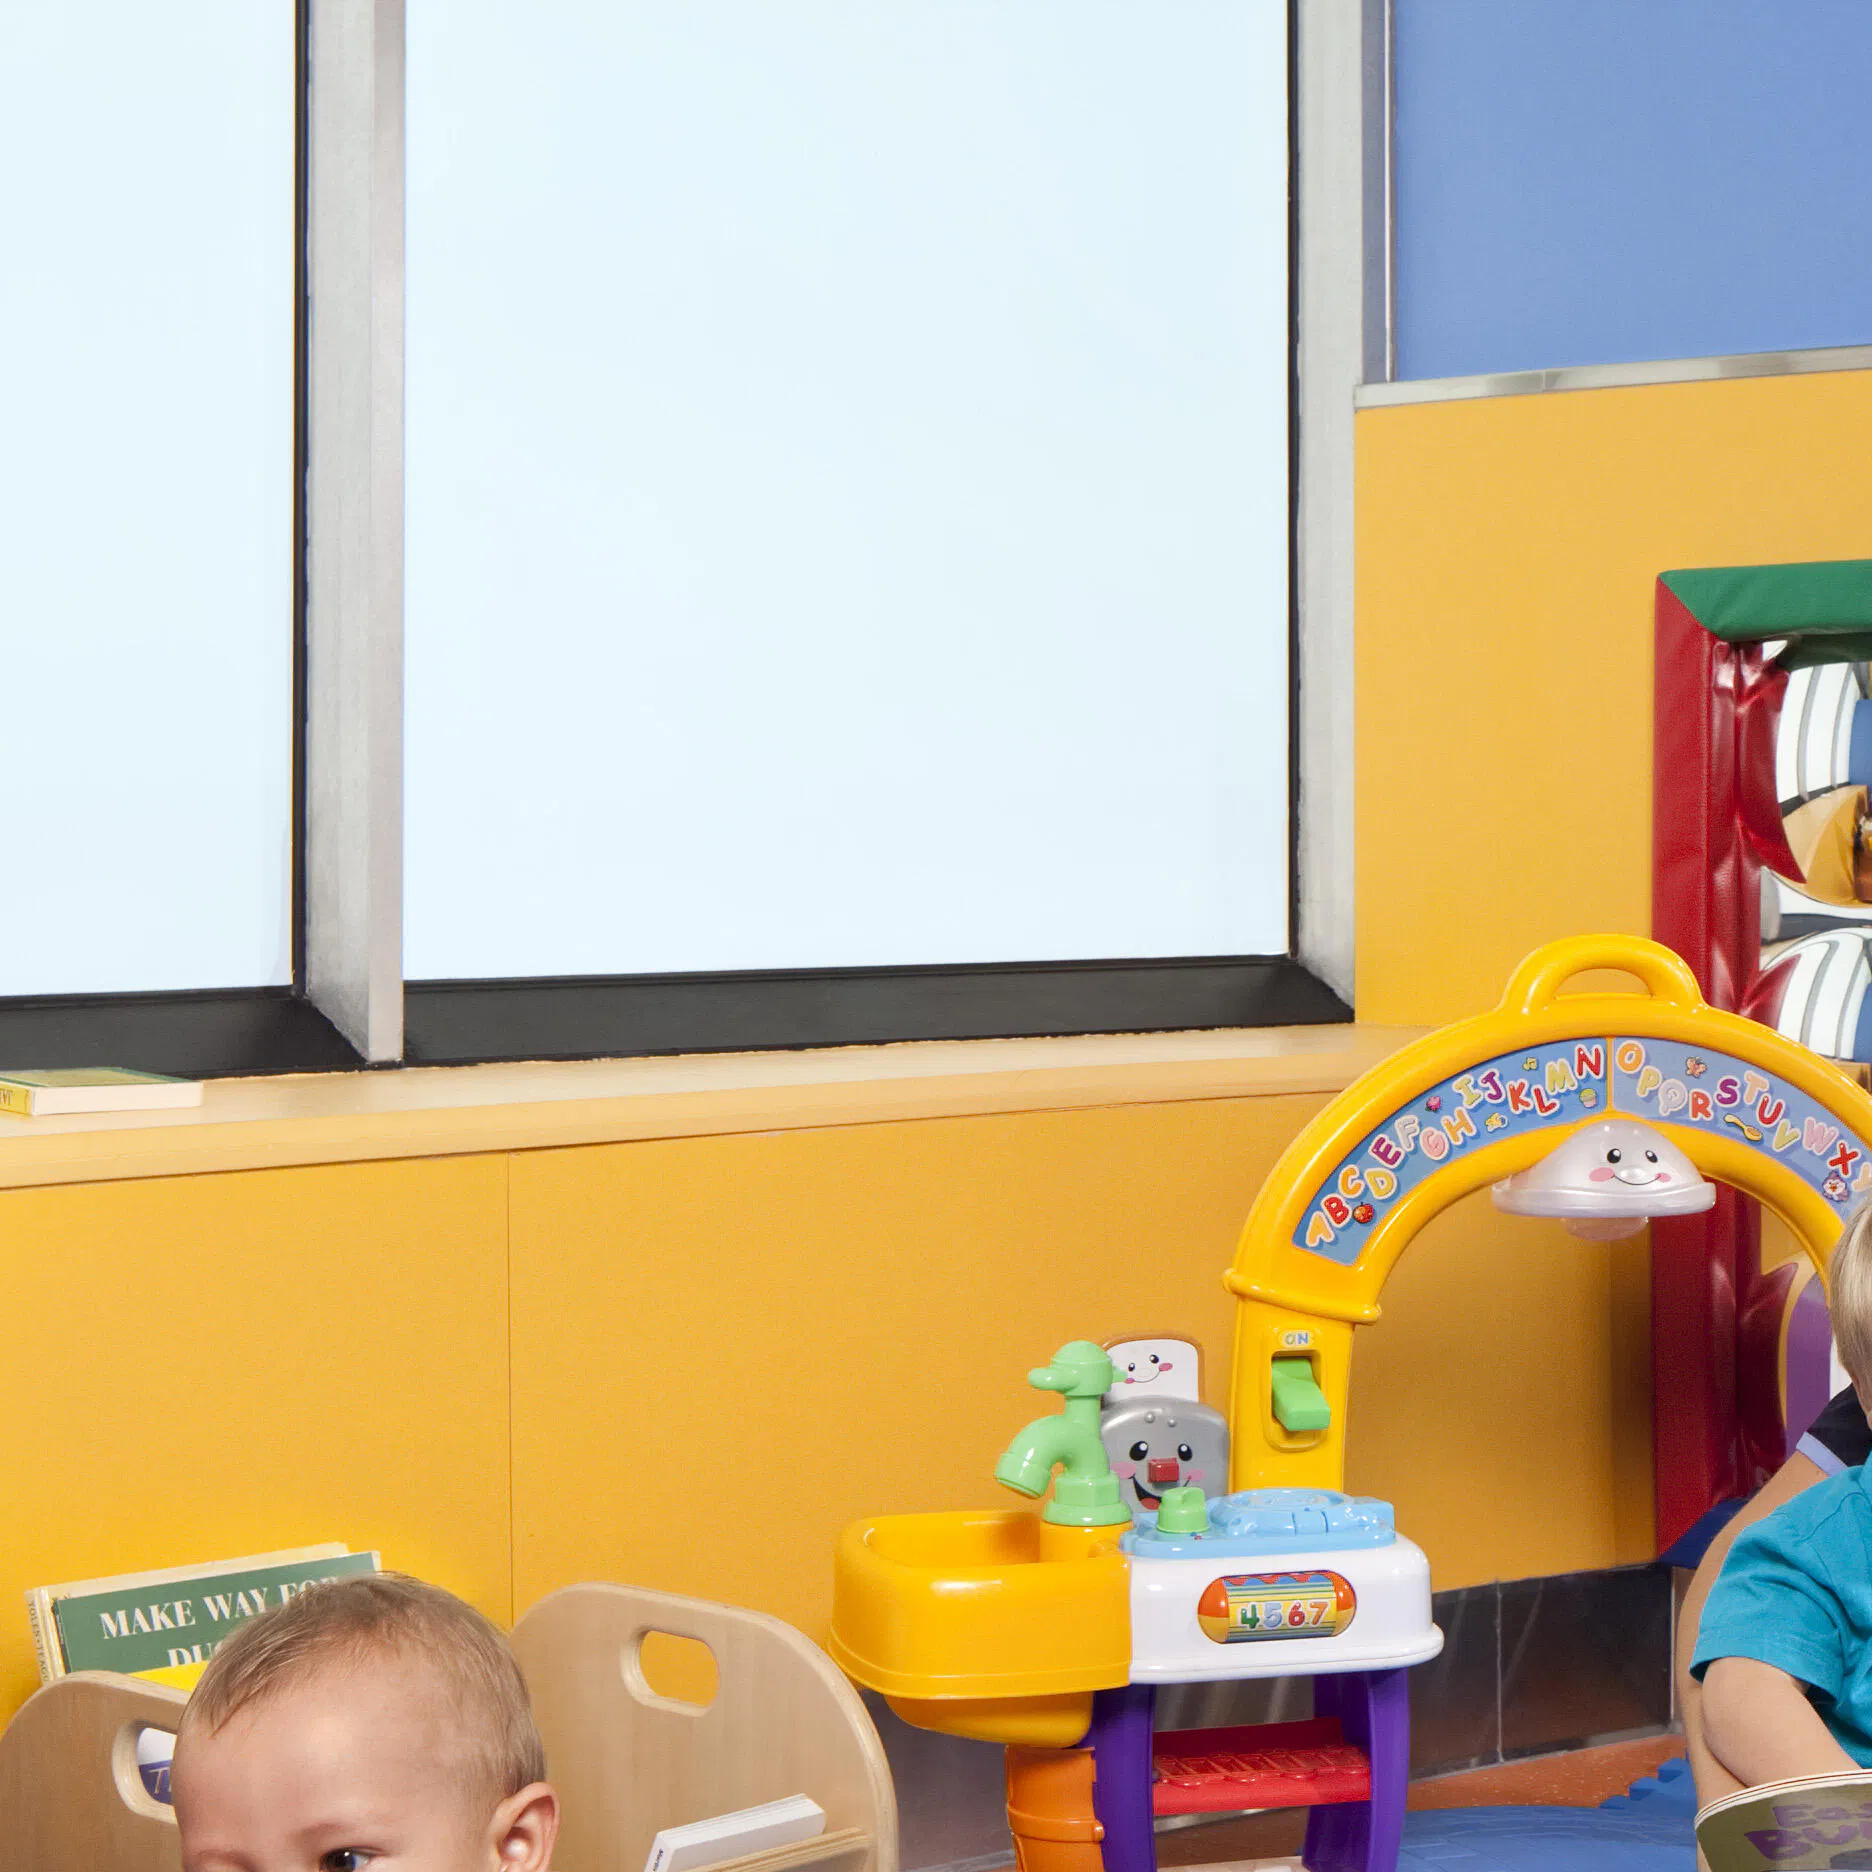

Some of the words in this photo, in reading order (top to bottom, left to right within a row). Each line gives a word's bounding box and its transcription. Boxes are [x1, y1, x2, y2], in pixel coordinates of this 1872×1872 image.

[1283, 1332, 1310, 1346] ON
[99, 1600, 196, 1639] MAKE
[203, 1588, 268, 1622] WAY
